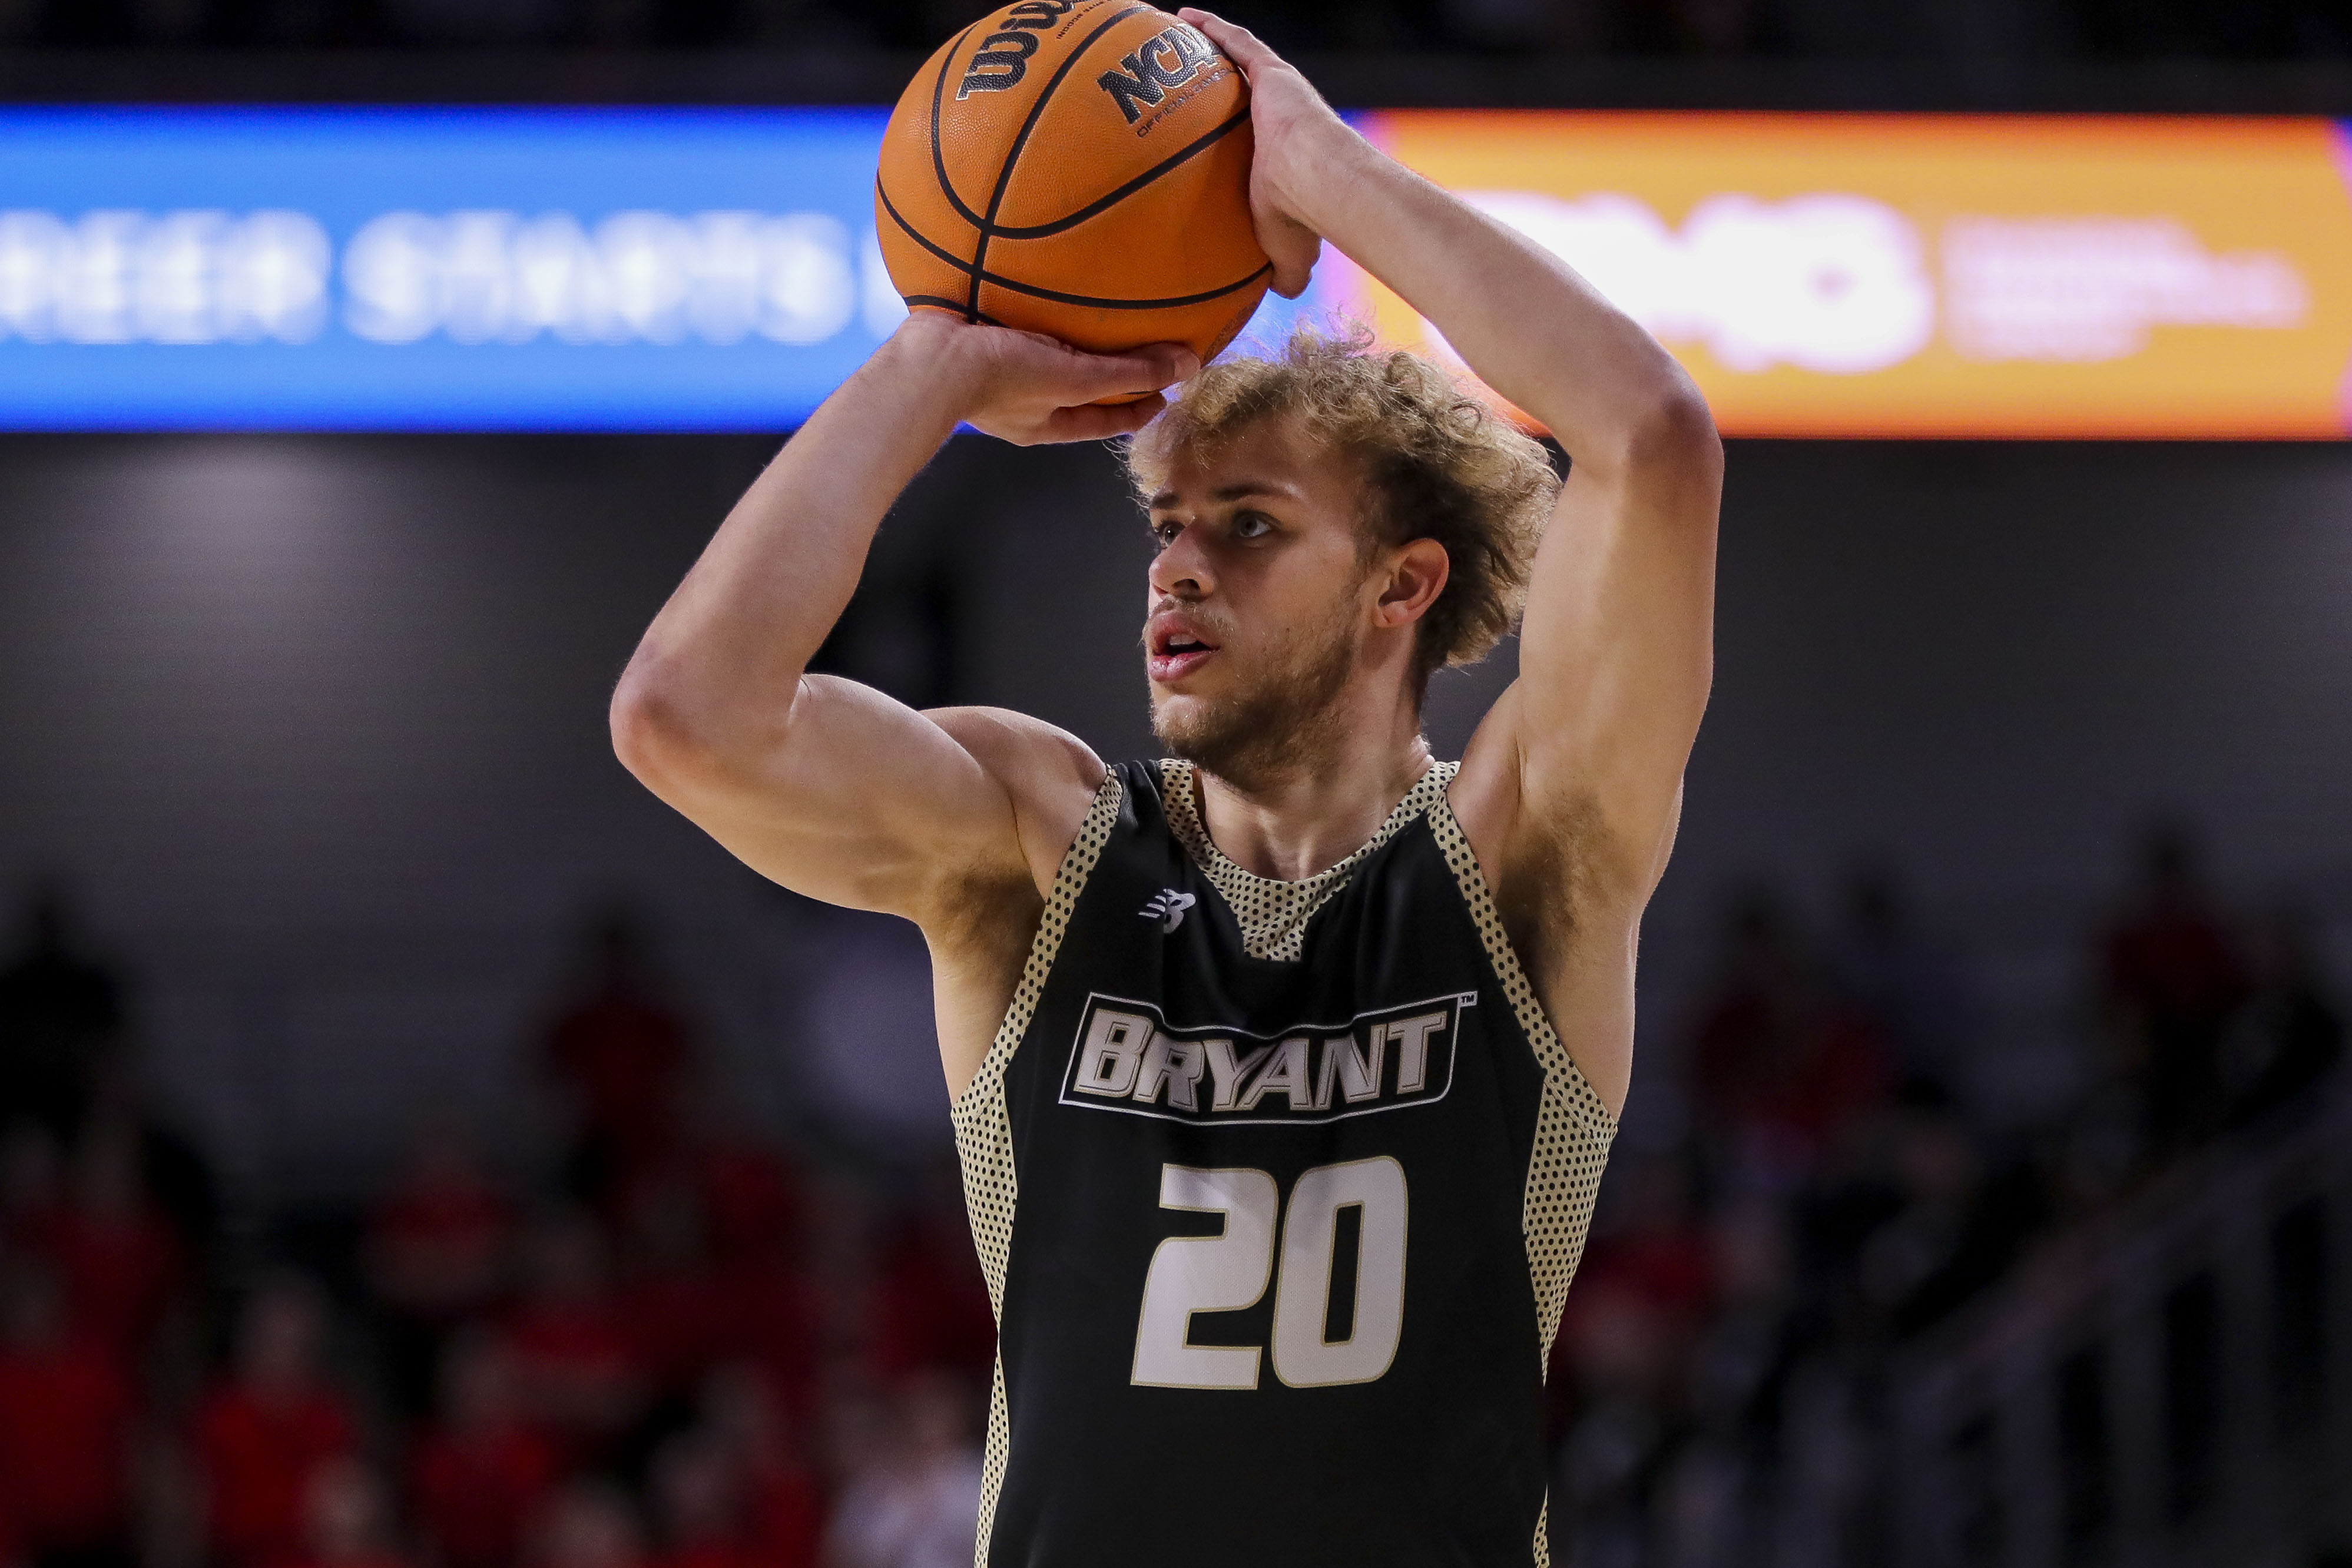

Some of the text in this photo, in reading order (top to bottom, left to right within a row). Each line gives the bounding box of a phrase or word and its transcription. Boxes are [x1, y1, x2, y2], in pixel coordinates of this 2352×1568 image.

[1056, 13, 1083, 39] INDOOR
[1096, 22, 1222, 126] NCAA
[1136, 93, 1194, 138] OFFICIAL
[342, 210, 854, 346] STARTS
[1073, 1009, 1447, 1112] BRYANT
[1130, 1155, 1409, 1390] 20
